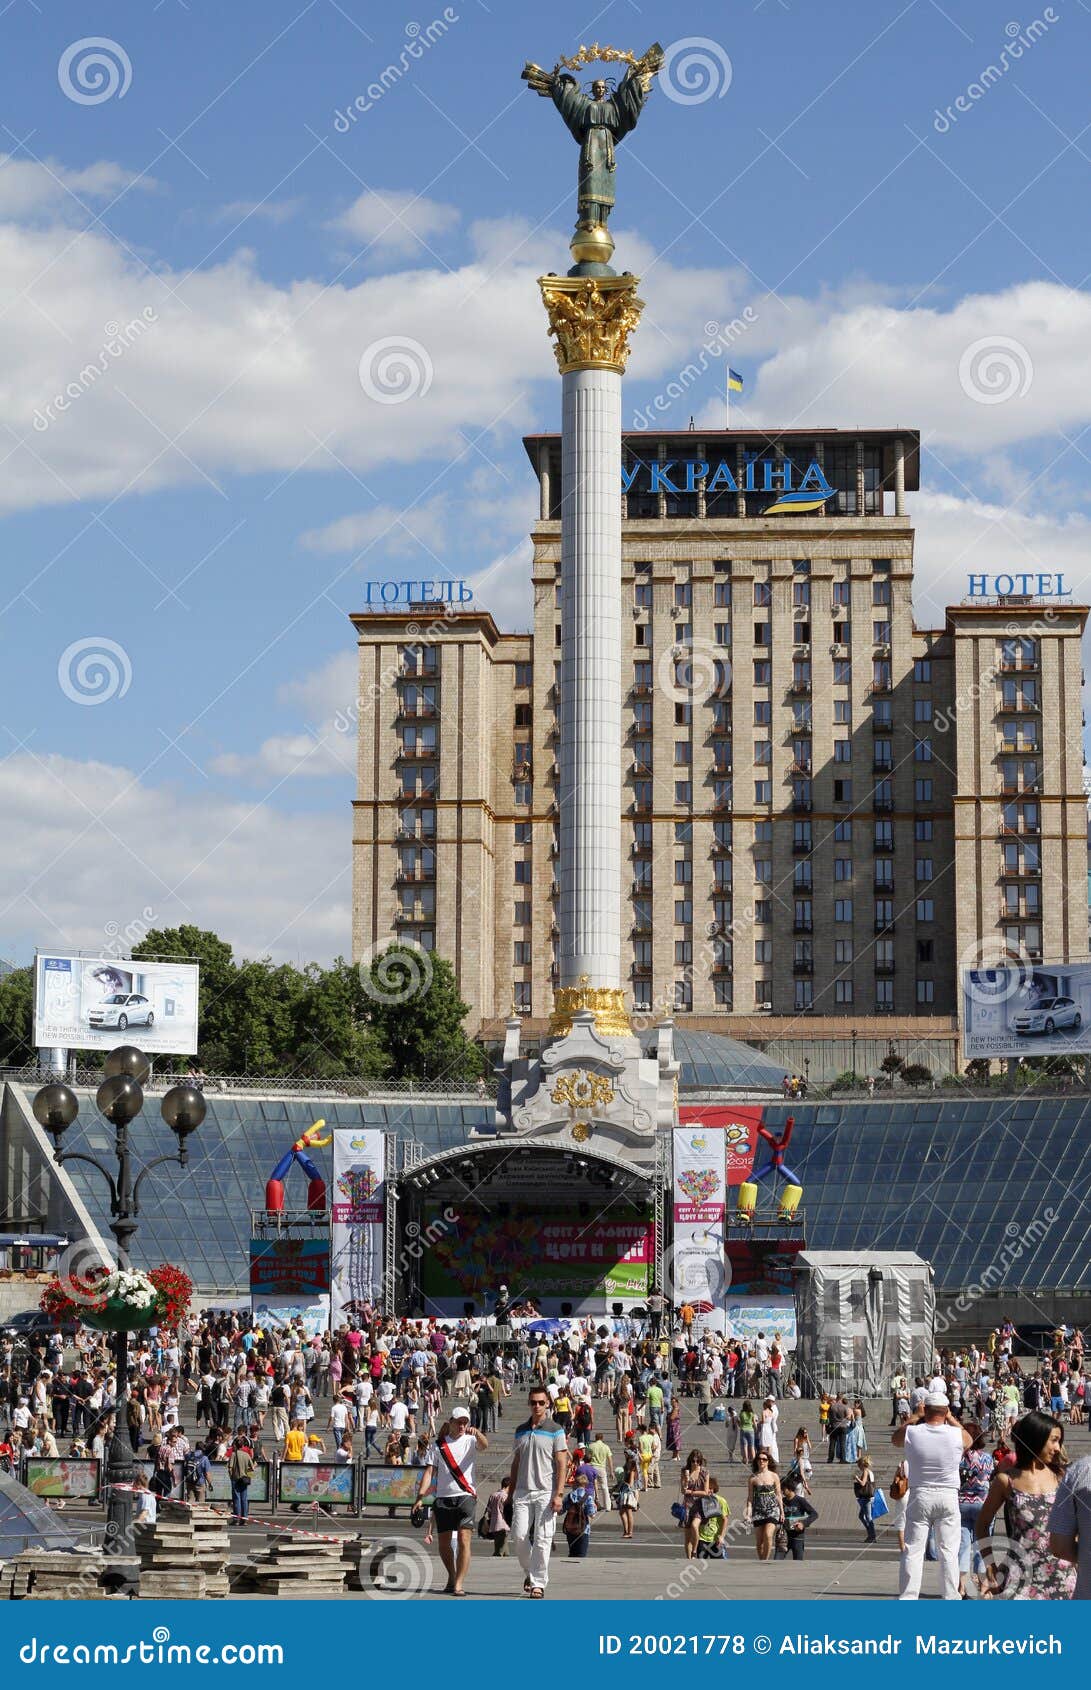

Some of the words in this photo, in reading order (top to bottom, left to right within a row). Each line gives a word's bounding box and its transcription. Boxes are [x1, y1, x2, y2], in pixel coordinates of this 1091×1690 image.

[621, 452, 833, 493] УКРАЇНА
[365, 580, 474, 604] ГОТЕЛЬ
[967, 573, 1073, 597] HOTEL
